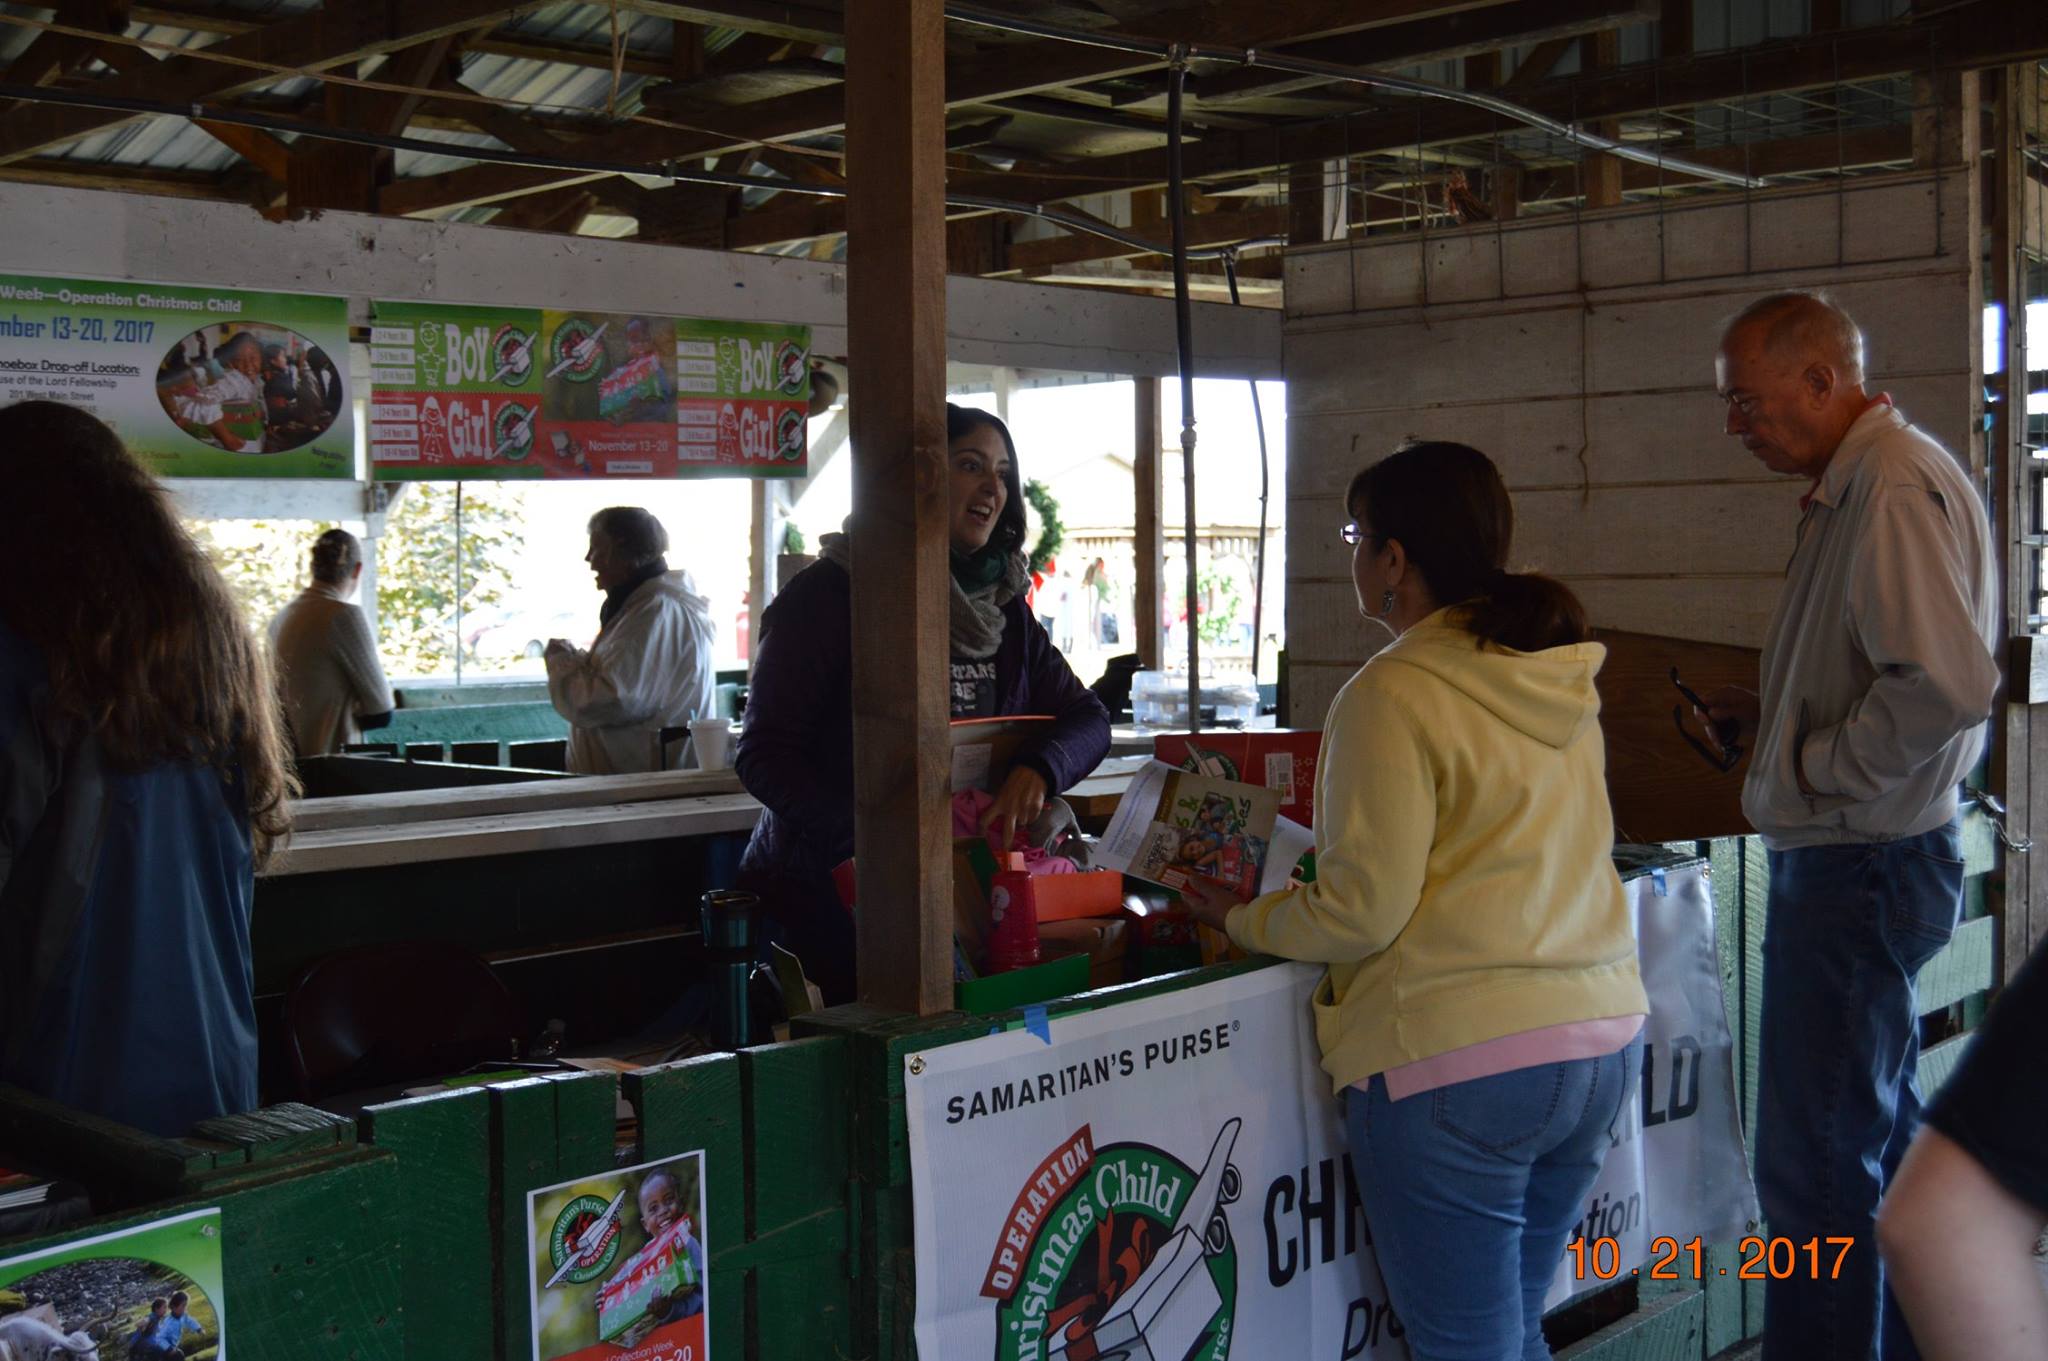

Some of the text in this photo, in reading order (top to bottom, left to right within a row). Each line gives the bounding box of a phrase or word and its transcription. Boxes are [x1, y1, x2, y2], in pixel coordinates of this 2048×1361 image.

[137, 293, 204, 311] Christmas
[207, 298, 242, 313] Child
[52, 316, 107, 343] 13-20,
[113, 320, 155, 343] 2017
[41, 360, 89, 373] Drop-off
[46, 377, 67, 387] Lord
[69, 378, 117, 390] Fellowship
[588, 440, 636, 453] November
[946, 1048, 1135, 1125] SAMARITAN'S
[1095, 1160, 1182, 1219] Child
[580, 1198, 606, 1216] Purse
[991, 1138, 1091, 1291] OPERATION
[580, 1226, 616, 1267] OPERATION
[602, 1240, 617, 1263] Child
[652, 1338, 675, 1355] Week
